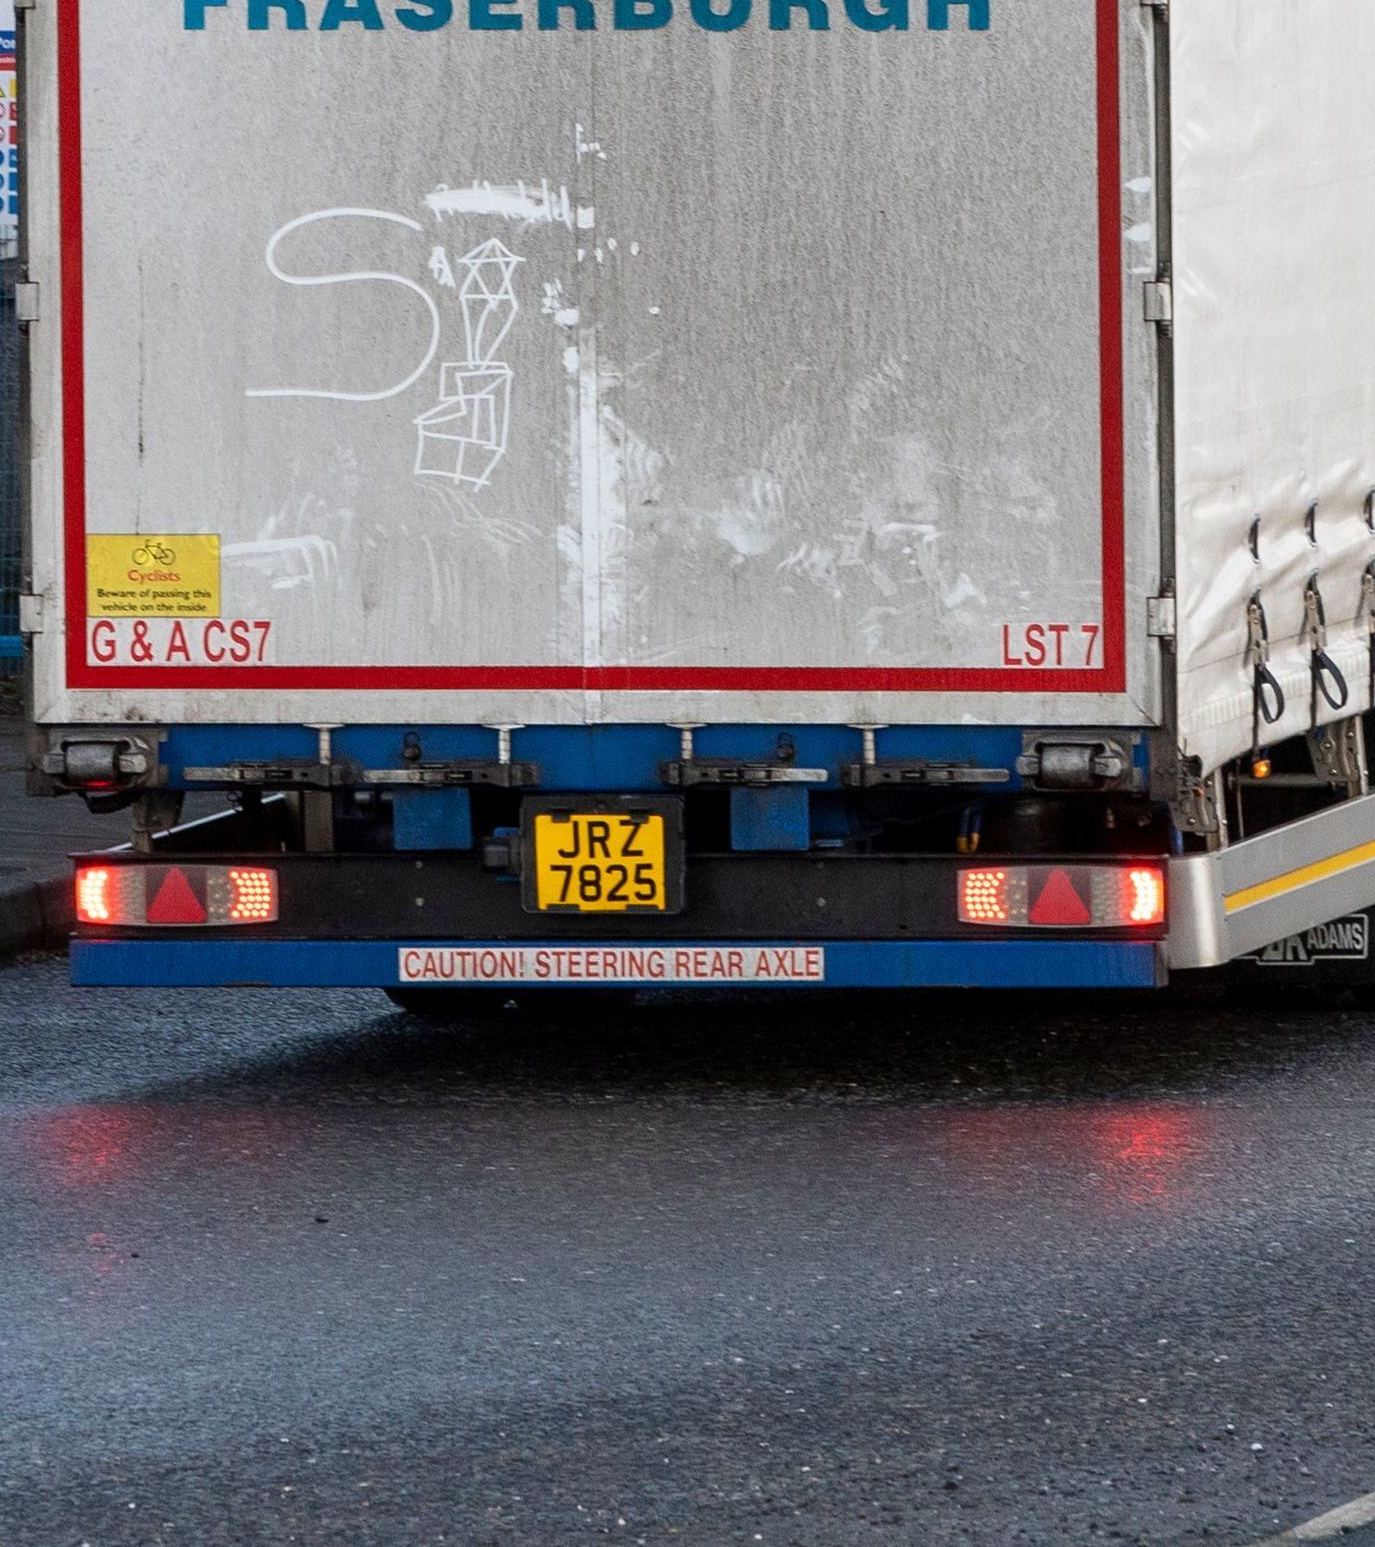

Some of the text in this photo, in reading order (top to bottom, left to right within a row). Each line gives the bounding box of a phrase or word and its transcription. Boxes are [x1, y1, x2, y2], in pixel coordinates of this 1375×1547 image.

[127, 569, 181, 584] Cyclists
[97, 588, 212, 601] Beware of passing this
[101, 602, 207, 612] vehicle on the inside
[91, 619, 272, 663] G & A CS7
[1002, 623, 1100, 667] LST 7
[557, 819, 644, 859] JRZ
[549, 863, 658, 903] 7825
[1306, 921, 1364, 951] ADAMS
[403, 949, 821, 979] CAUTION! STEERING REAR AXLE
